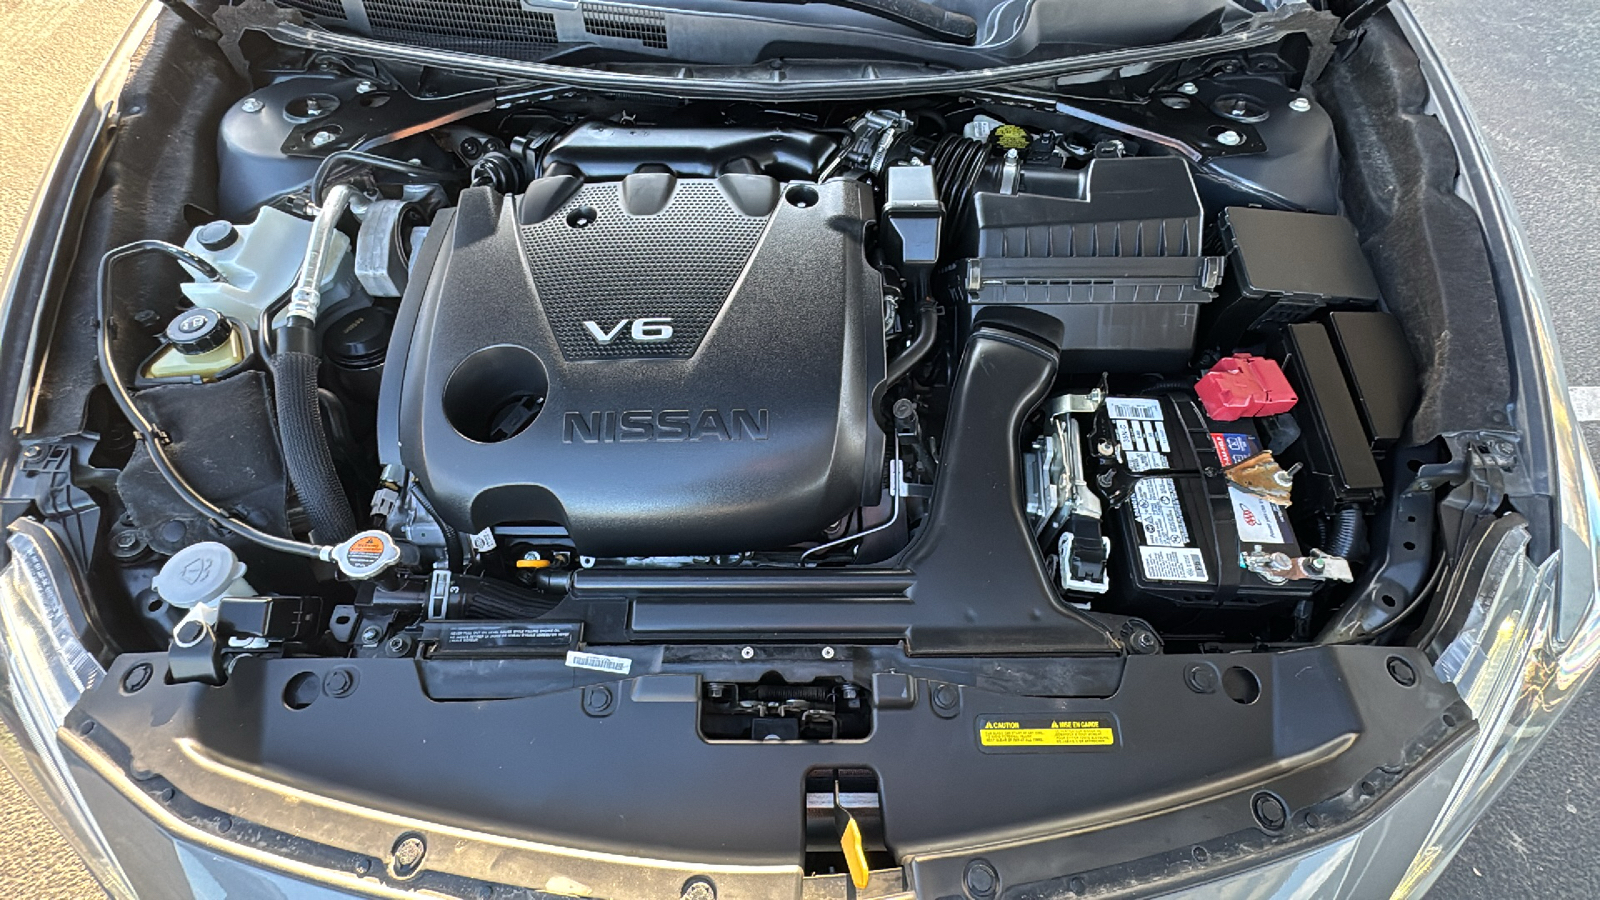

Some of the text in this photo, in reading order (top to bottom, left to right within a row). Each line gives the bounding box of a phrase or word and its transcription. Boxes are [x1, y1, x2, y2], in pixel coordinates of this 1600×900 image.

[583, 318, 674, 345] V6
[562, 408, 769, 443] NISSAN
[1243, 509, 1256, 527] AAA
[450, 586, 460, 594] 3
